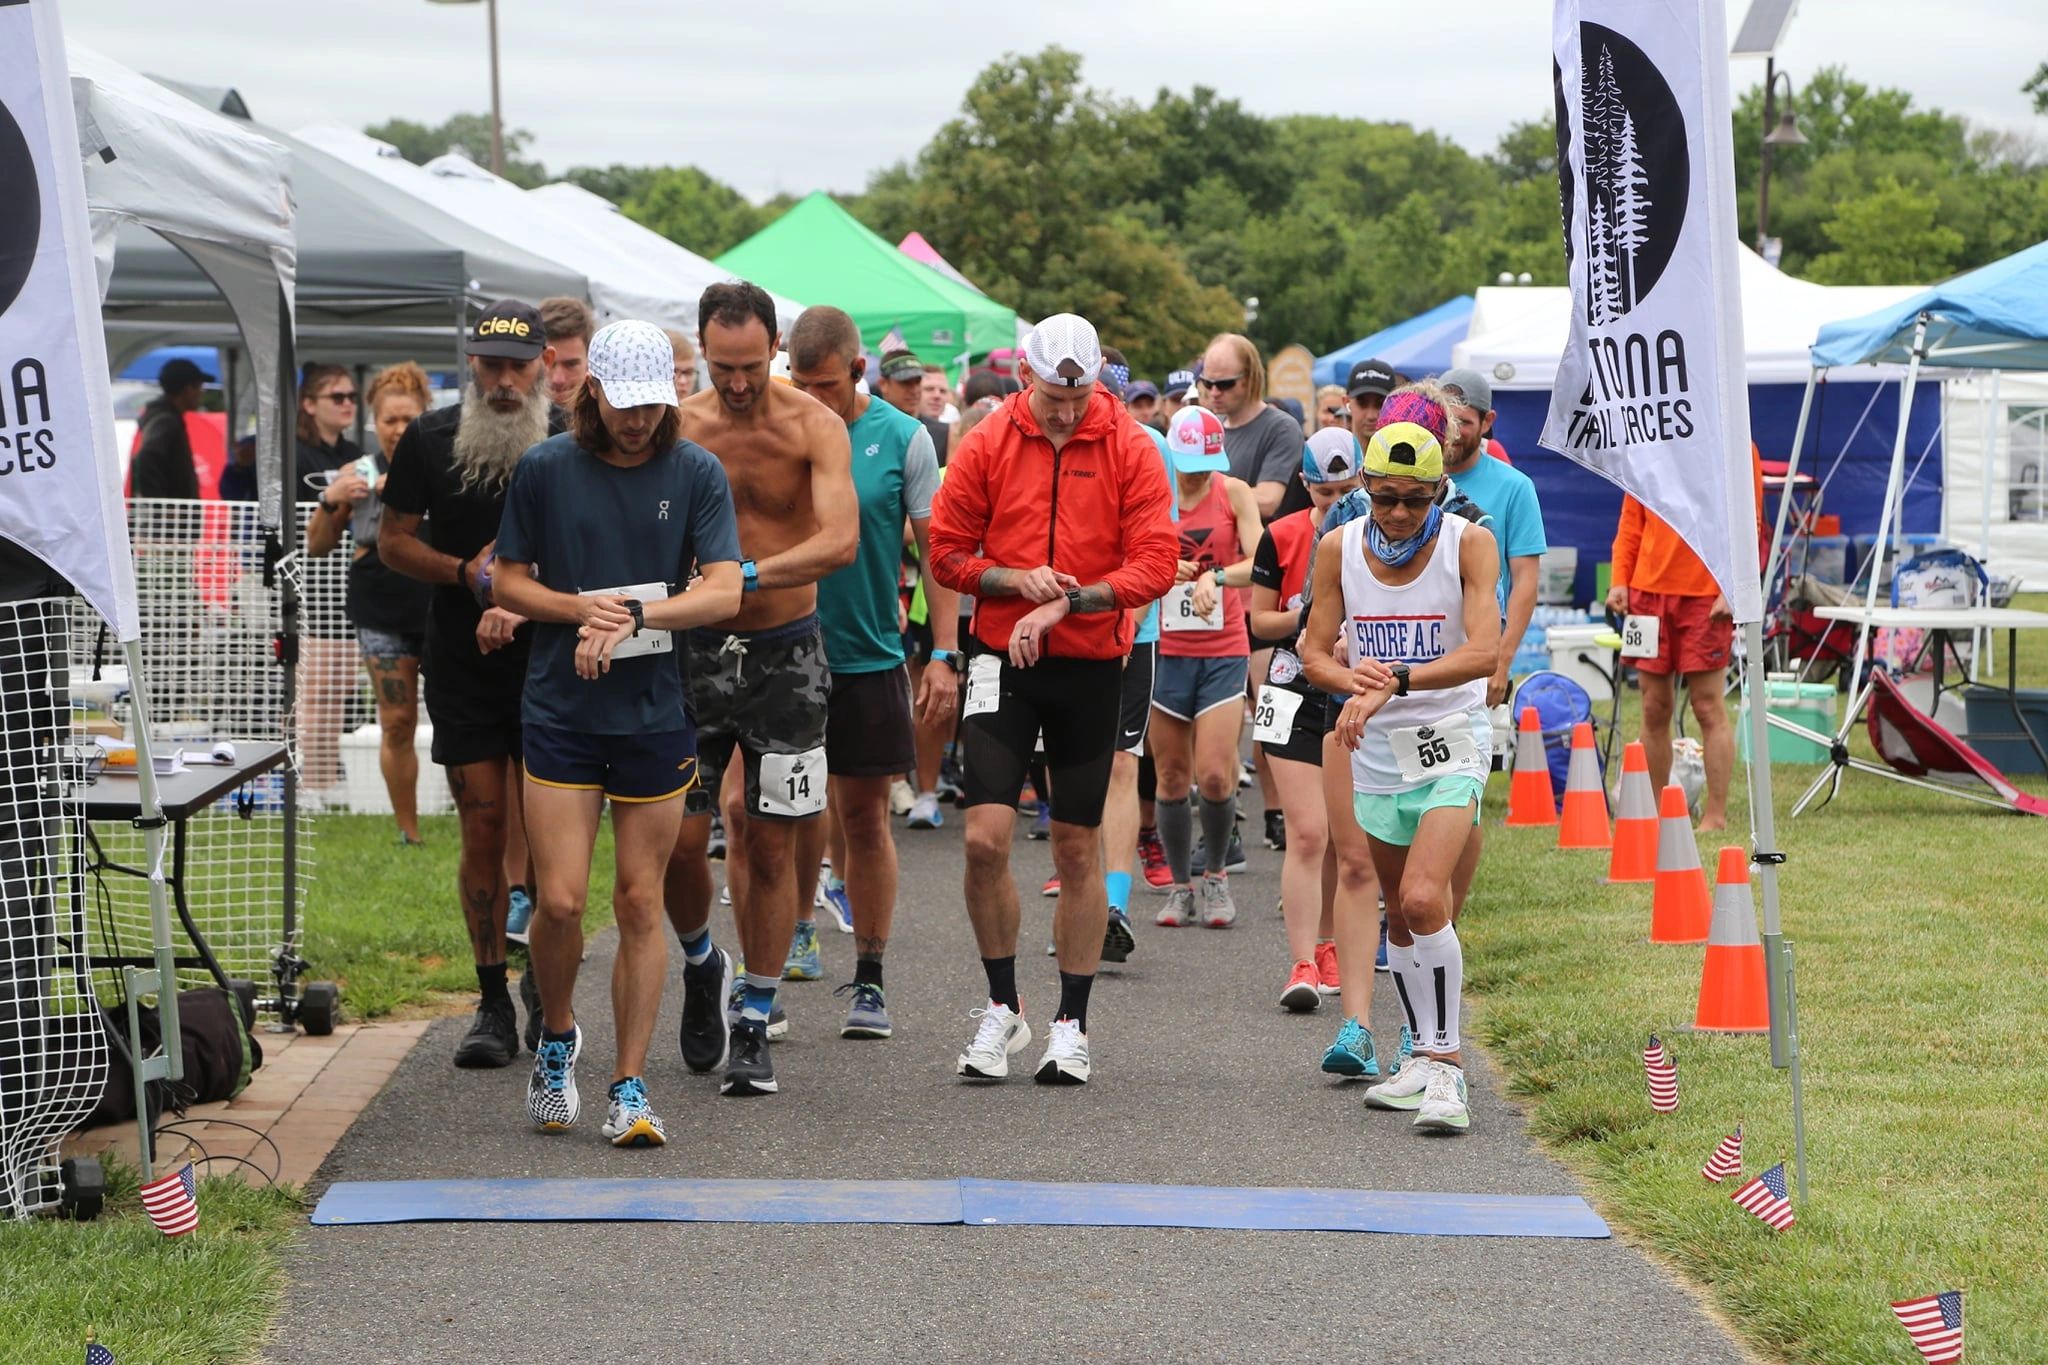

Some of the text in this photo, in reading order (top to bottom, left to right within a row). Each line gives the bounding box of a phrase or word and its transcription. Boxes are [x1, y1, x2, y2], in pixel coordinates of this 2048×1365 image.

[479, 316, 530, 337] ciele
[1579, 329, 1689, 406] TONA
[0, 357, 51, 428] A
[651, 640, 660, 649] 11
[1356, 622, 1445, 657] SHORE A.C.
[1626, 631, 1642, 646] 58
[1256, 706, 1275, 727] 29
[1417, 737, 1450, 768] 55
[786, 774, 810, 801] 14
